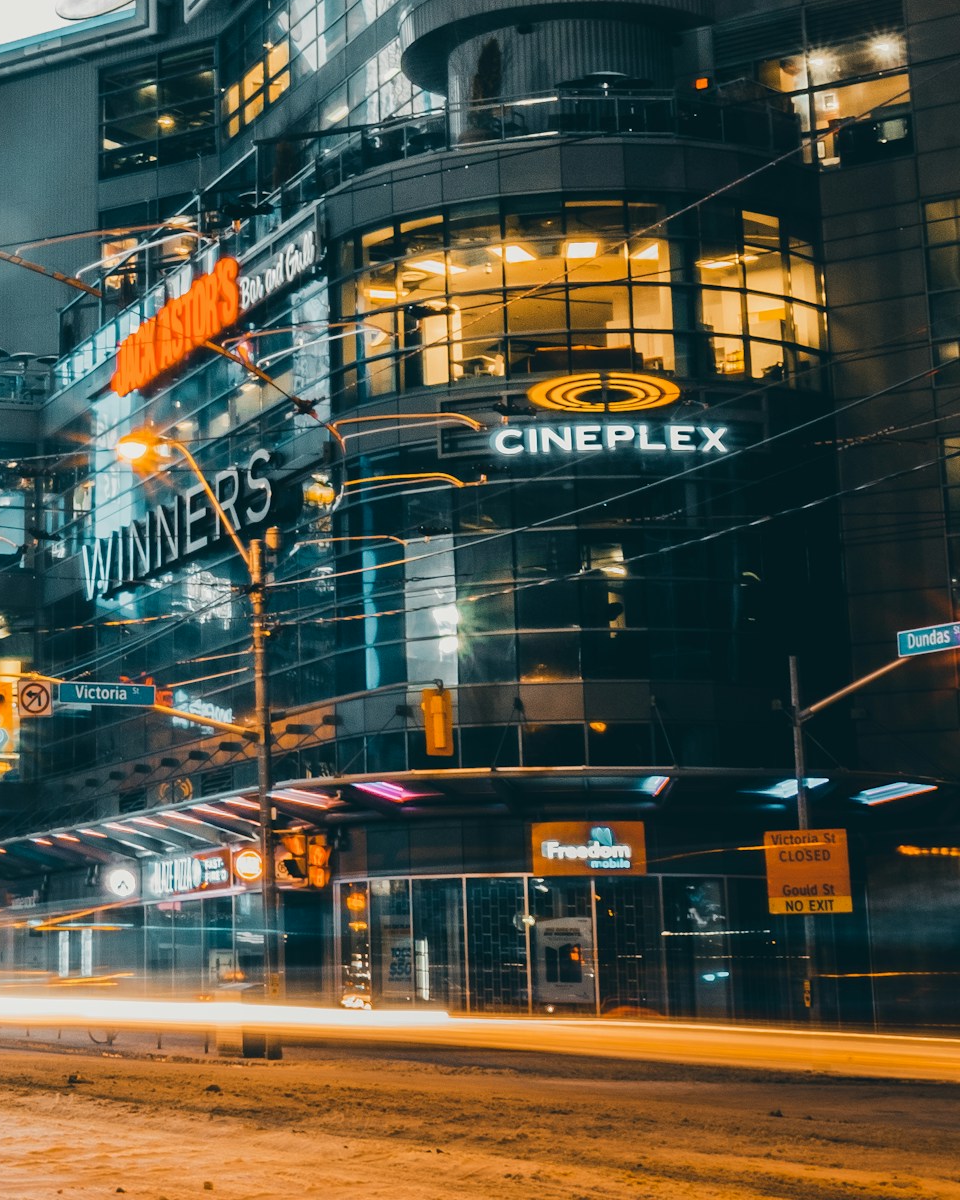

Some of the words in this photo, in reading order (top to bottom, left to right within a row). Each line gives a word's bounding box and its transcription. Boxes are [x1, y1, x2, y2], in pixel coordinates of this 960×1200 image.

[240, 275, 264, 310] Bar
[265, 252, 285, 294] and
[492, 424, 727, 455] CINEPLEX
[82, 447, 273, 601] WINNERS
[908, 629, 951, 649] Dundas
[75, 684, 127, 701] Victoria
[132, 687, 140, 695] St
[771, 833, 819, 846] Victoria
[823, 832, 836, 844] St
[544, 840, 631, 859] Freedom
[779, 849, 831, 862] CLOSED
[590, 858, 630, 868] mobile
[782, 884, 817, 896] Gould
[822, 883, 836, 896] St
[785, 900, 803, 912] NO
[809, 899, 834, 911] EXIT
